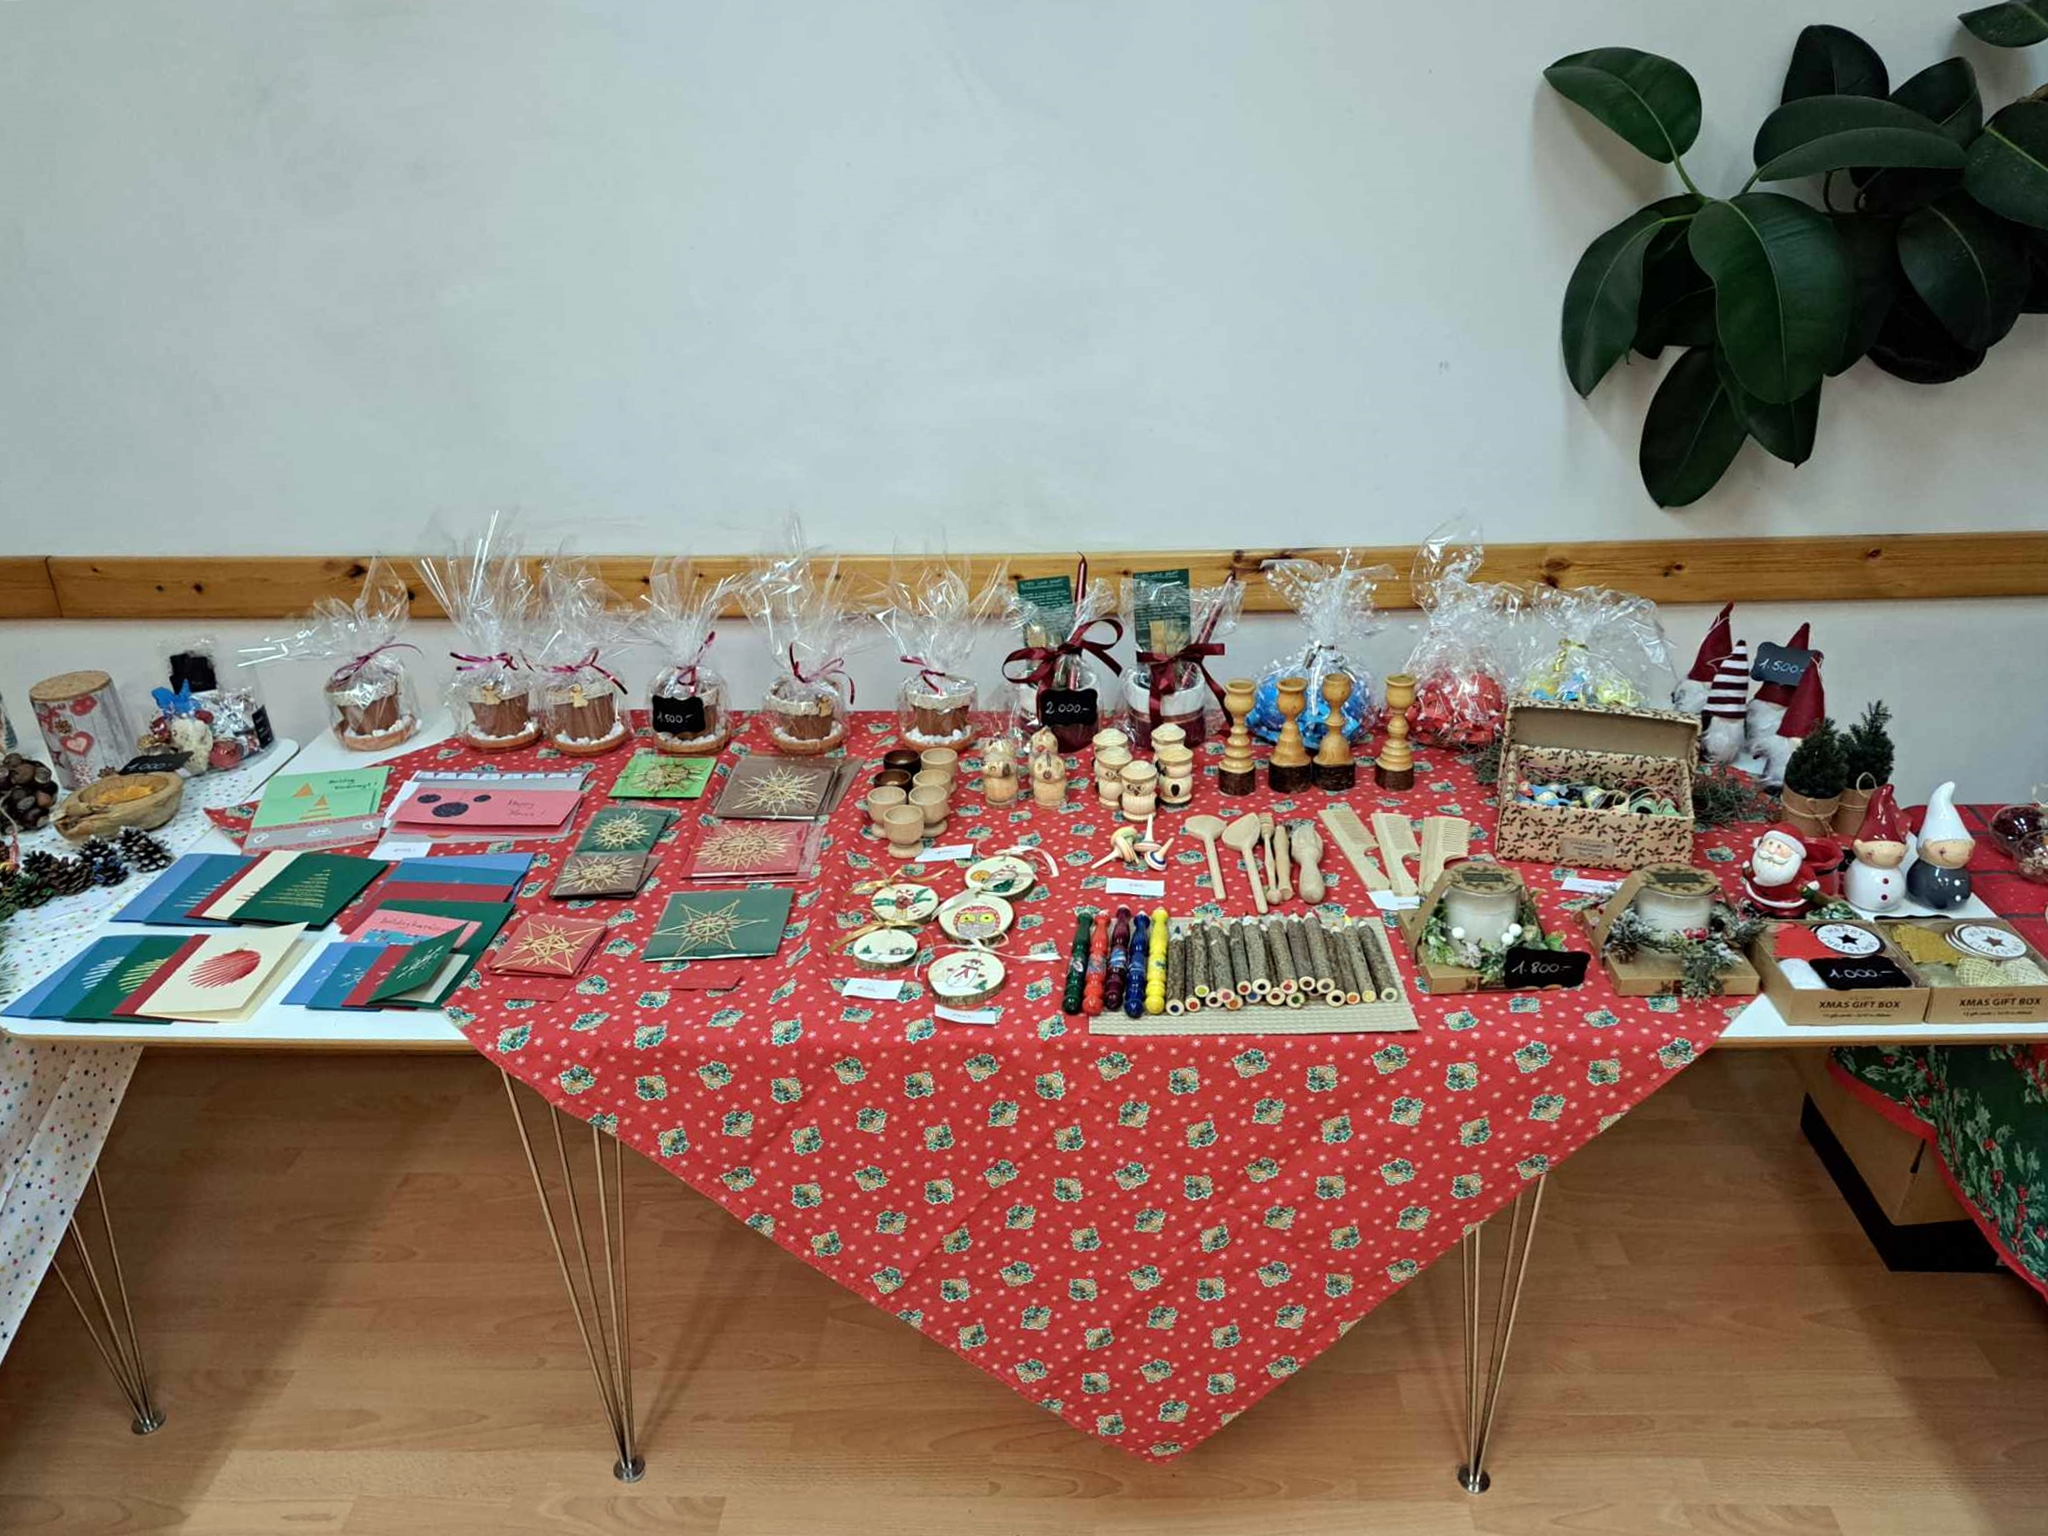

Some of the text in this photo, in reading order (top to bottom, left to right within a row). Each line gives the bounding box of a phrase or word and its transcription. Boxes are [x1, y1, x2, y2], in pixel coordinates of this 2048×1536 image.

[1819, 1000, 1901, 1009] XMAS GIFT BOX
[1959, 998, 2041, 1007] XMAS GIFT BOX
